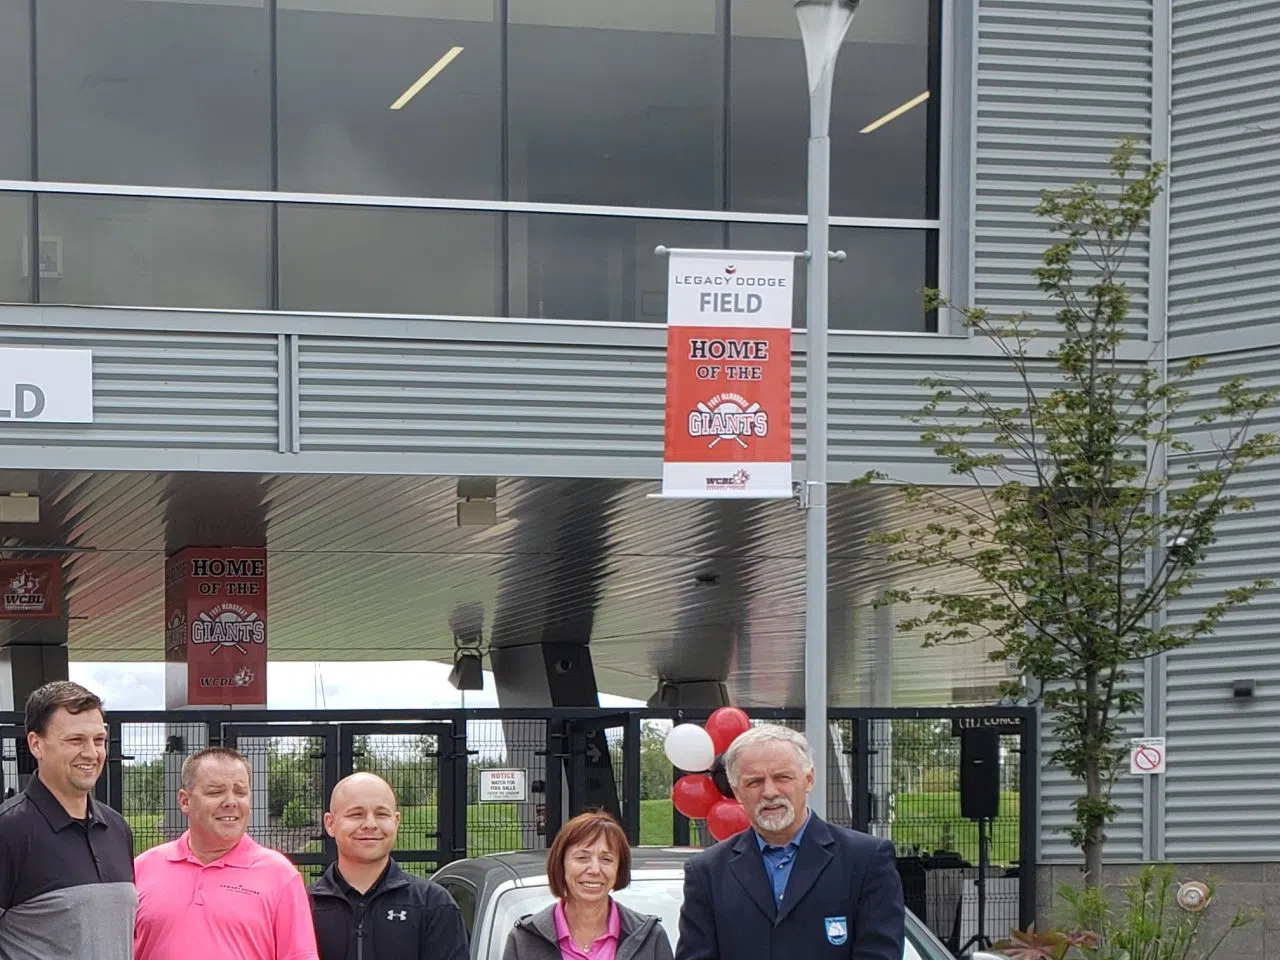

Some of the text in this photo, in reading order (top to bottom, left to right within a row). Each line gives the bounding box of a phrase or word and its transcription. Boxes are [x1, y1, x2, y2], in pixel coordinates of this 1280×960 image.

[675, 275, 786, 287] LEGACY DODGE
[699, 292, 762, 314] FIELD
[689, 340, 768, 360] HOME
[697, 366, 761, 380] OF THE
[688, 411, 768, 437] GIANTS
[192, 558, 265, 578] HOME
[5, 594, 44, 604] WCBL
[198, 583, 259, 595] OF THE
[192, 620, 265, 644] GIANTS
